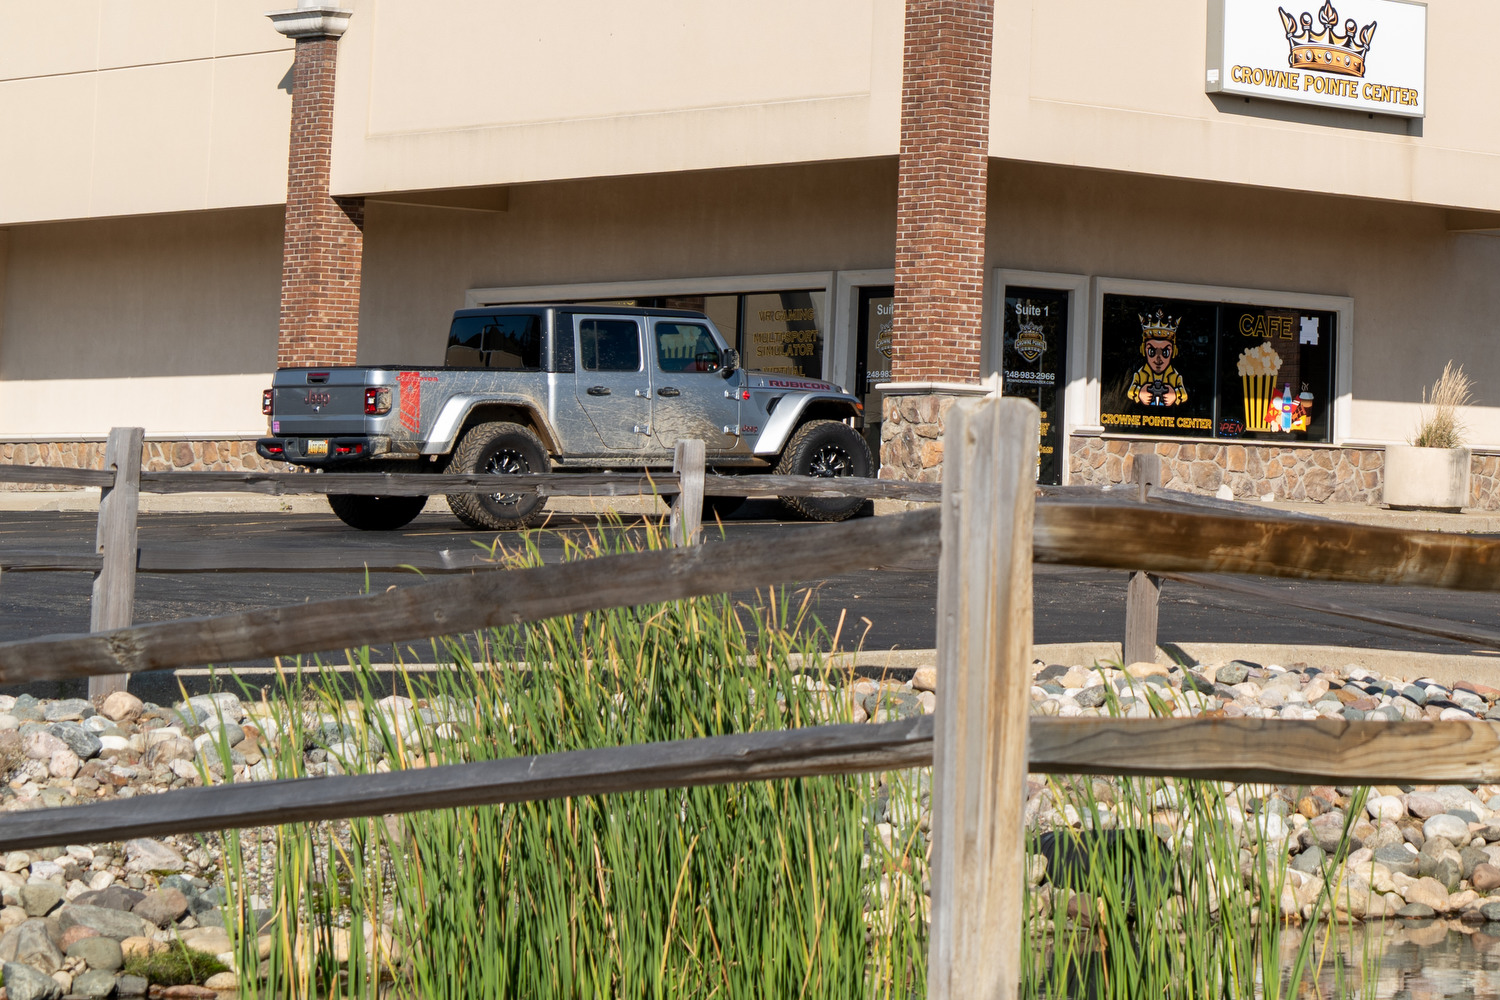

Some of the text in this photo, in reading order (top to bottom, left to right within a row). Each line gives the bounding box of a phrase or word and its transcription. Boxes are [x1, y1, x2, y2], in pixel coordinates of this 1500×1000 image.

[1231, 65, 1418, 107] CROWNE POINTE CENTER
[759, 309, 814, 321] VR GAMING
[877, 304, 894, 315] Suit
[1015, 303, 1049, 317] Suite 1
[1239, 313, 1293, 340] CAFE
[757, 344, 814, 356] SIMULATOR
[1005, 370, 1055, 380] 248-983-2966
[768, 379, 831, 390] RUBICON
[304, 390, 330, 408] Jeep
[1100, 413, 1213, 430] CROWNE POINTE CENTER
[741, 424, 758, 433] Jeep
